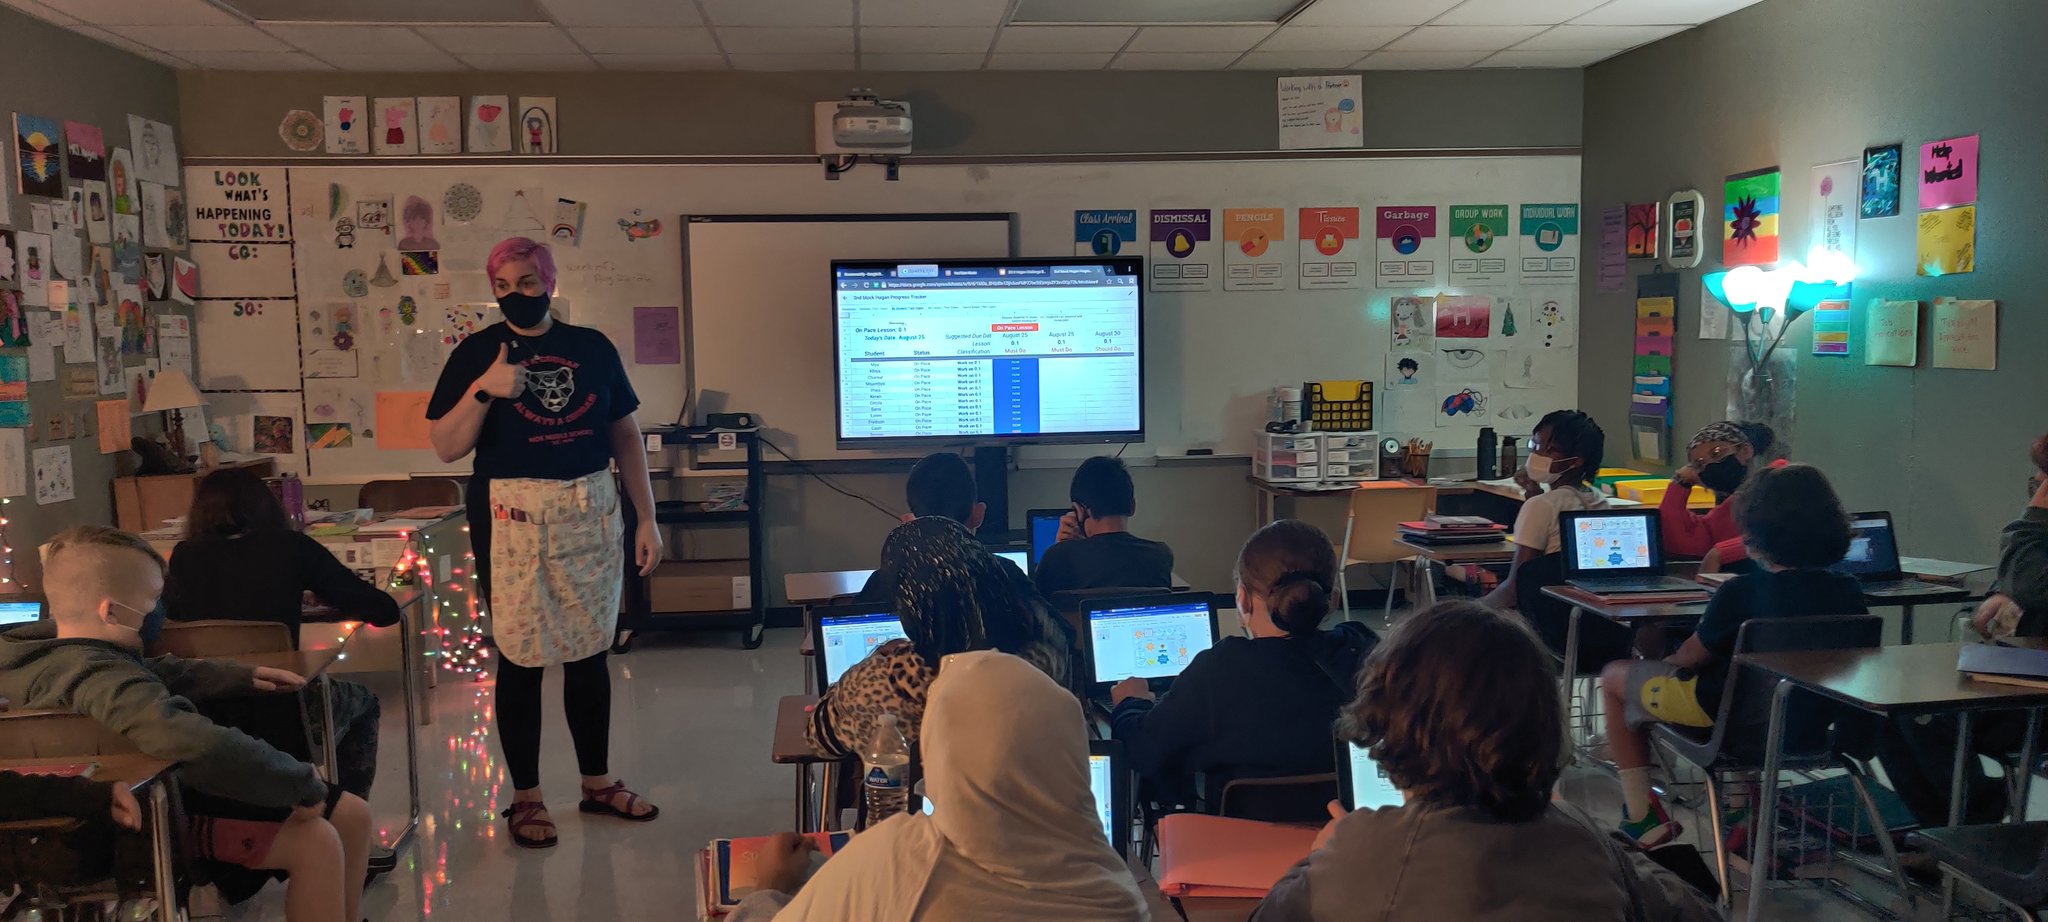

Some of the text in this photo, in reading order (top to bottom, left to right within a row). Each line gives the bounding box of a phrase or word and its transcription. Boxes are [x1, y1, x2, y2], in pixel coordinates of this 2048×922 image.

[214, 170, 262, 186] LOOK
[224, 188, 268, 202] WHAT'S
[196, 208, 272, 221] HAPPENING
[1080, 212, 1132, 224] Class Arrival
[1154, 214, 1208, 223] DISMISSAL
[1235, 214, 1274, 222] PENCILS
[1384, 210, 1429, 222] Garbage
[1455, 208, 1503, 219] GROUP WORK
[218, 223, 285, 238] TODAY!
